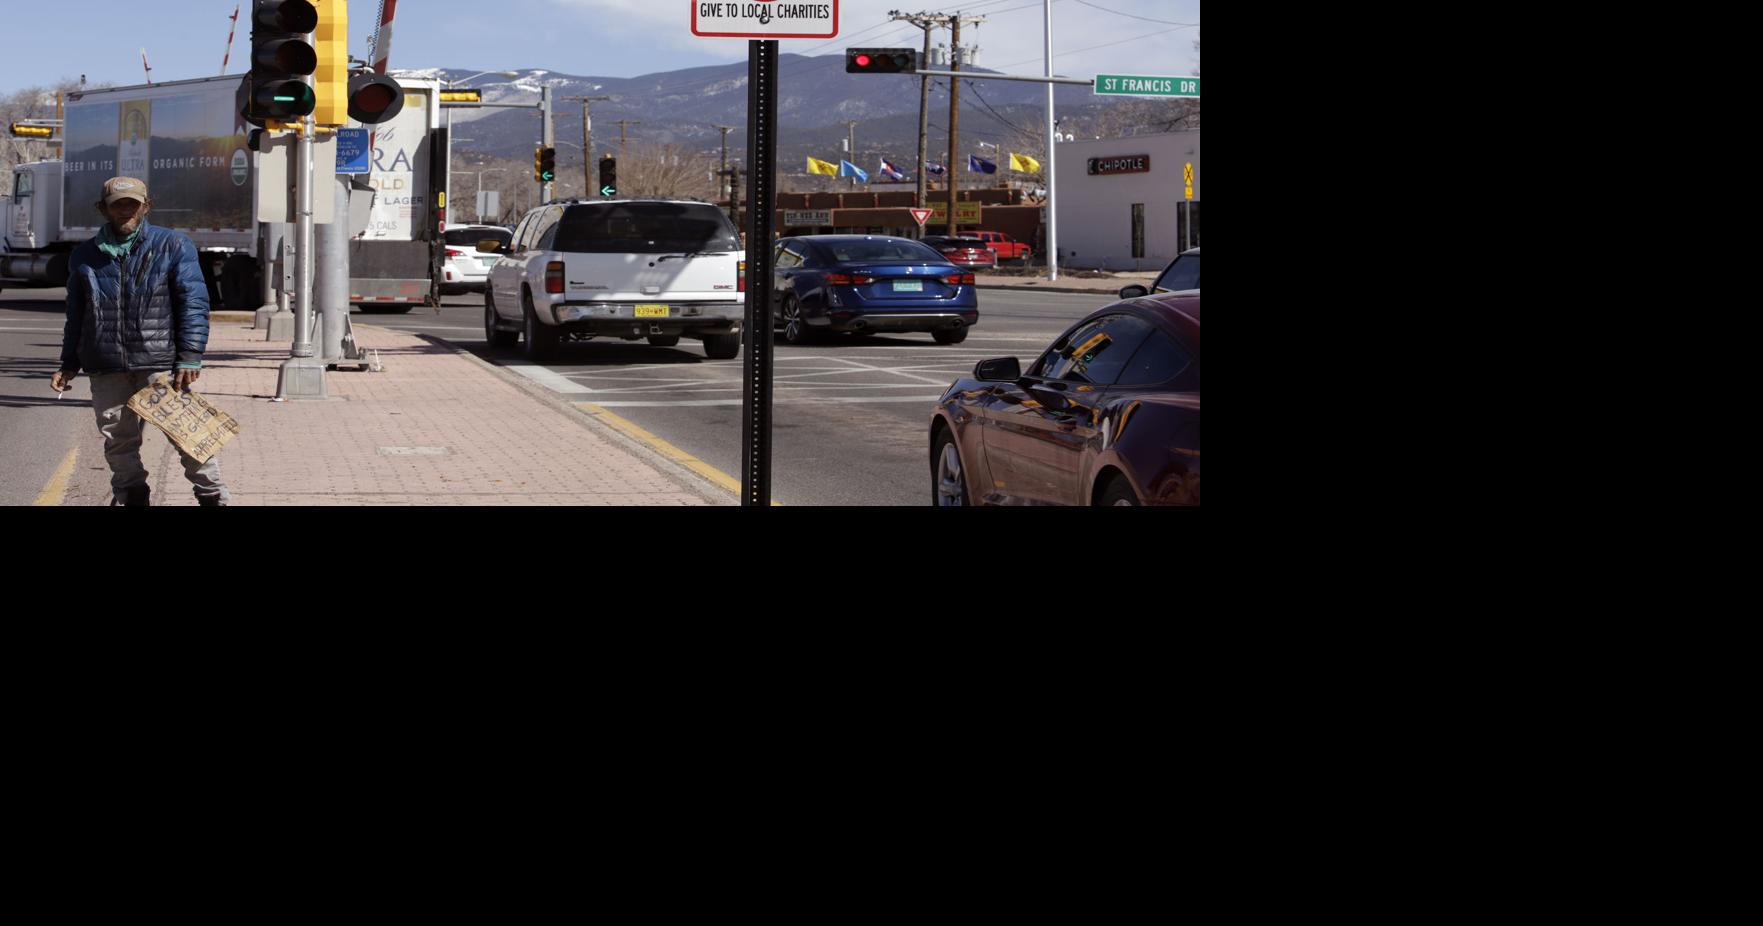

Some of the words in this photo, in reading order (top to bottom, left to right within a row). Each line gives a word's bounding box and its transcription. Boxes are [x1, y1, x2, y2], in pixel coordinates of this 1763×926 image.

[700, 3, 723, 18] GIVE
[726, 3, 738, 18] TO
[742, 3, 774, 19] LOCAL
[777, 4, 829, 19] CHARITIES
[1104, 78, 1117, 91] ST
[1122, 79, 1172, 92] FRANCIS
[1181, 81, 1196, 93] DR
[65, 161, 84, 173] BEER
[87, 161, 97, 172] IN
[101, 159, 114, 171] ITS
[153, 157, 195, 169] ORGANIC
[200, 156, 225, 168] FORM
[1098, 159, 1143, 171] CHIPOTLE
[384, 196, 424, 205] LAGER
[376, 220, 398, 230] CALS
[139, 382, 168, 409] GOD
[151, 393, 192, 421] BLESS
